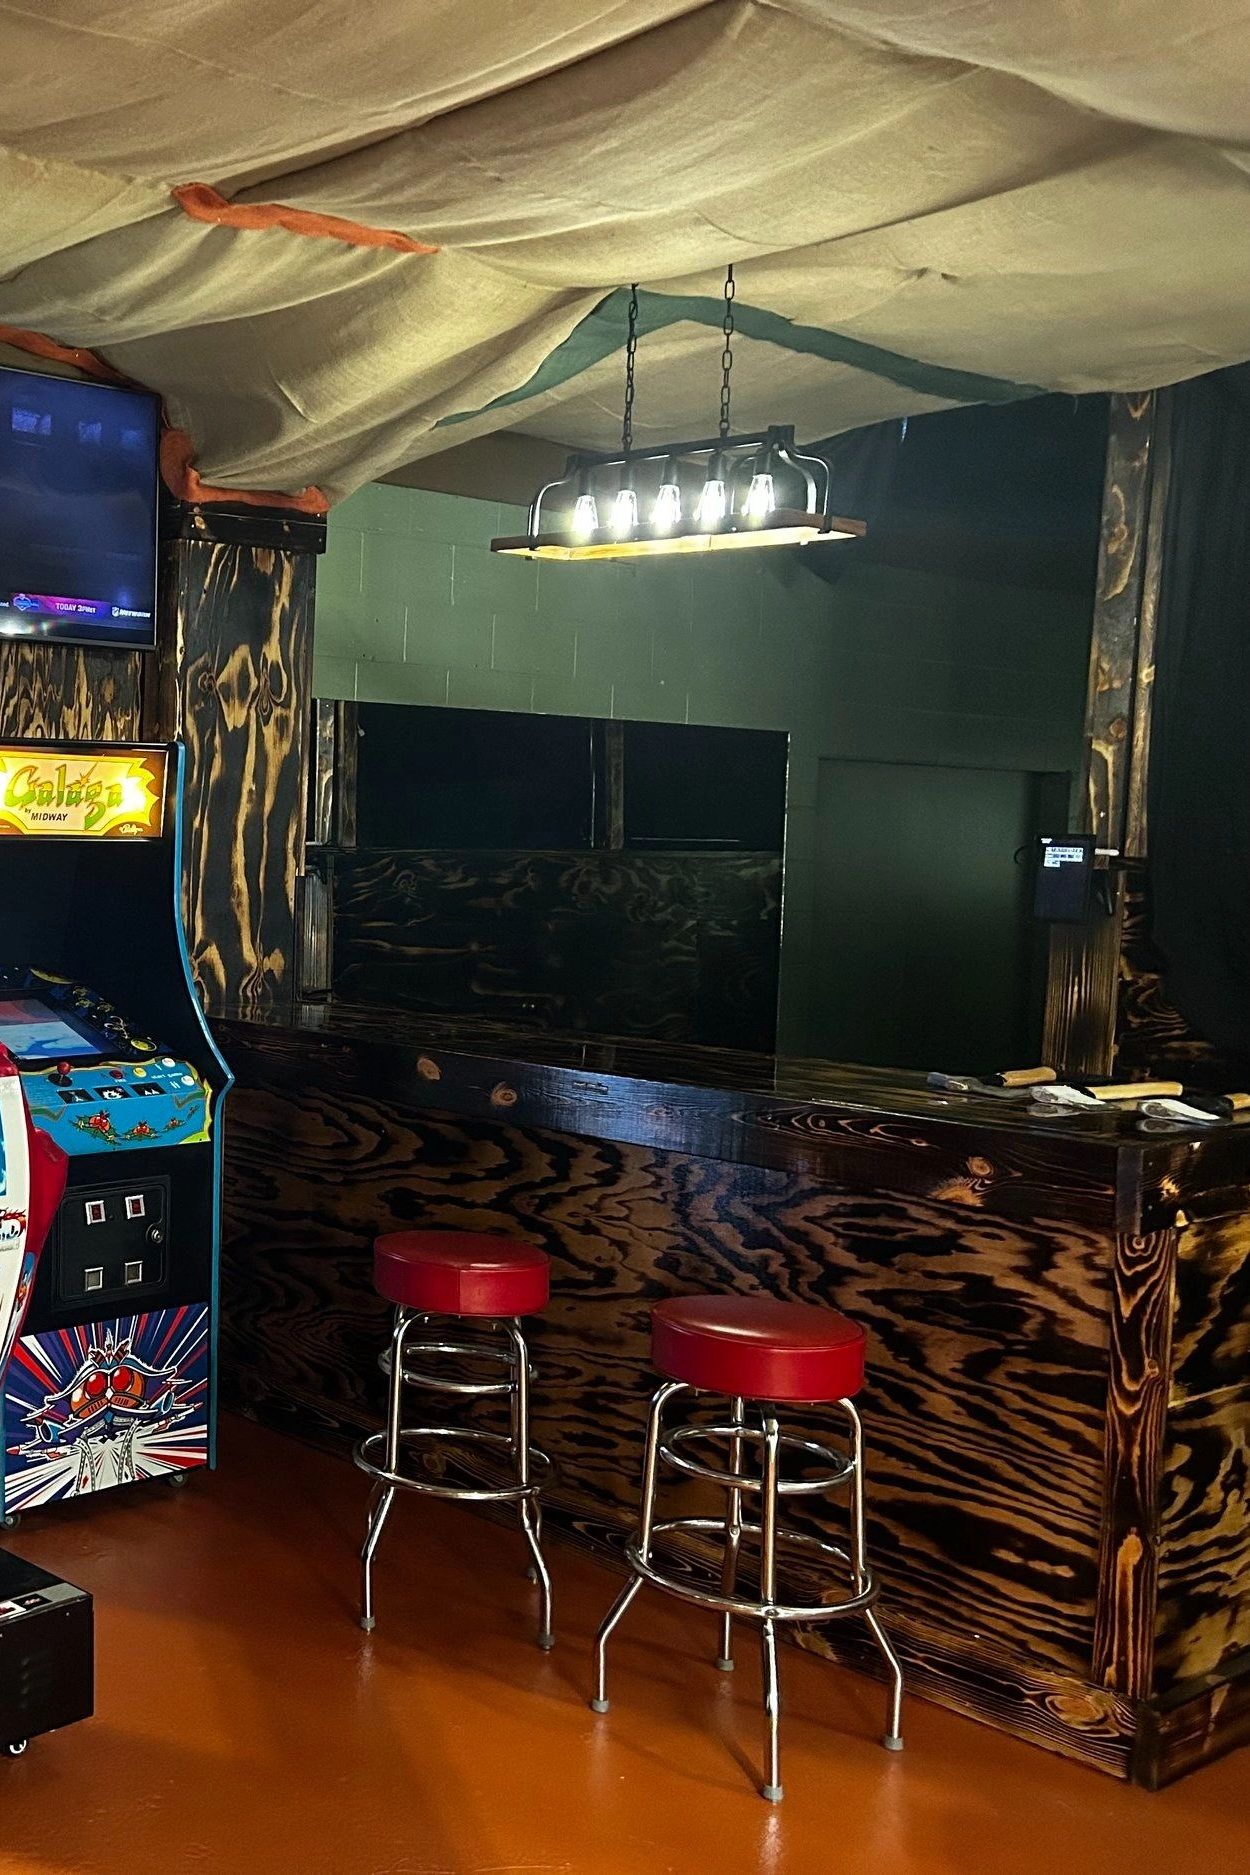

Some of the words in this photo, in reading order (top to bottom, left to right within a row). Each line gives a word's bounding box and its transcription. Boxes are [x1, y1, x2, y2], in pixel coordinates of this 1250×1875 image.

[55, 602, 76, 611] TODAY
[4, 763, 123, 831] Galaga
[31, 812, 68, 821] MIDWAY
